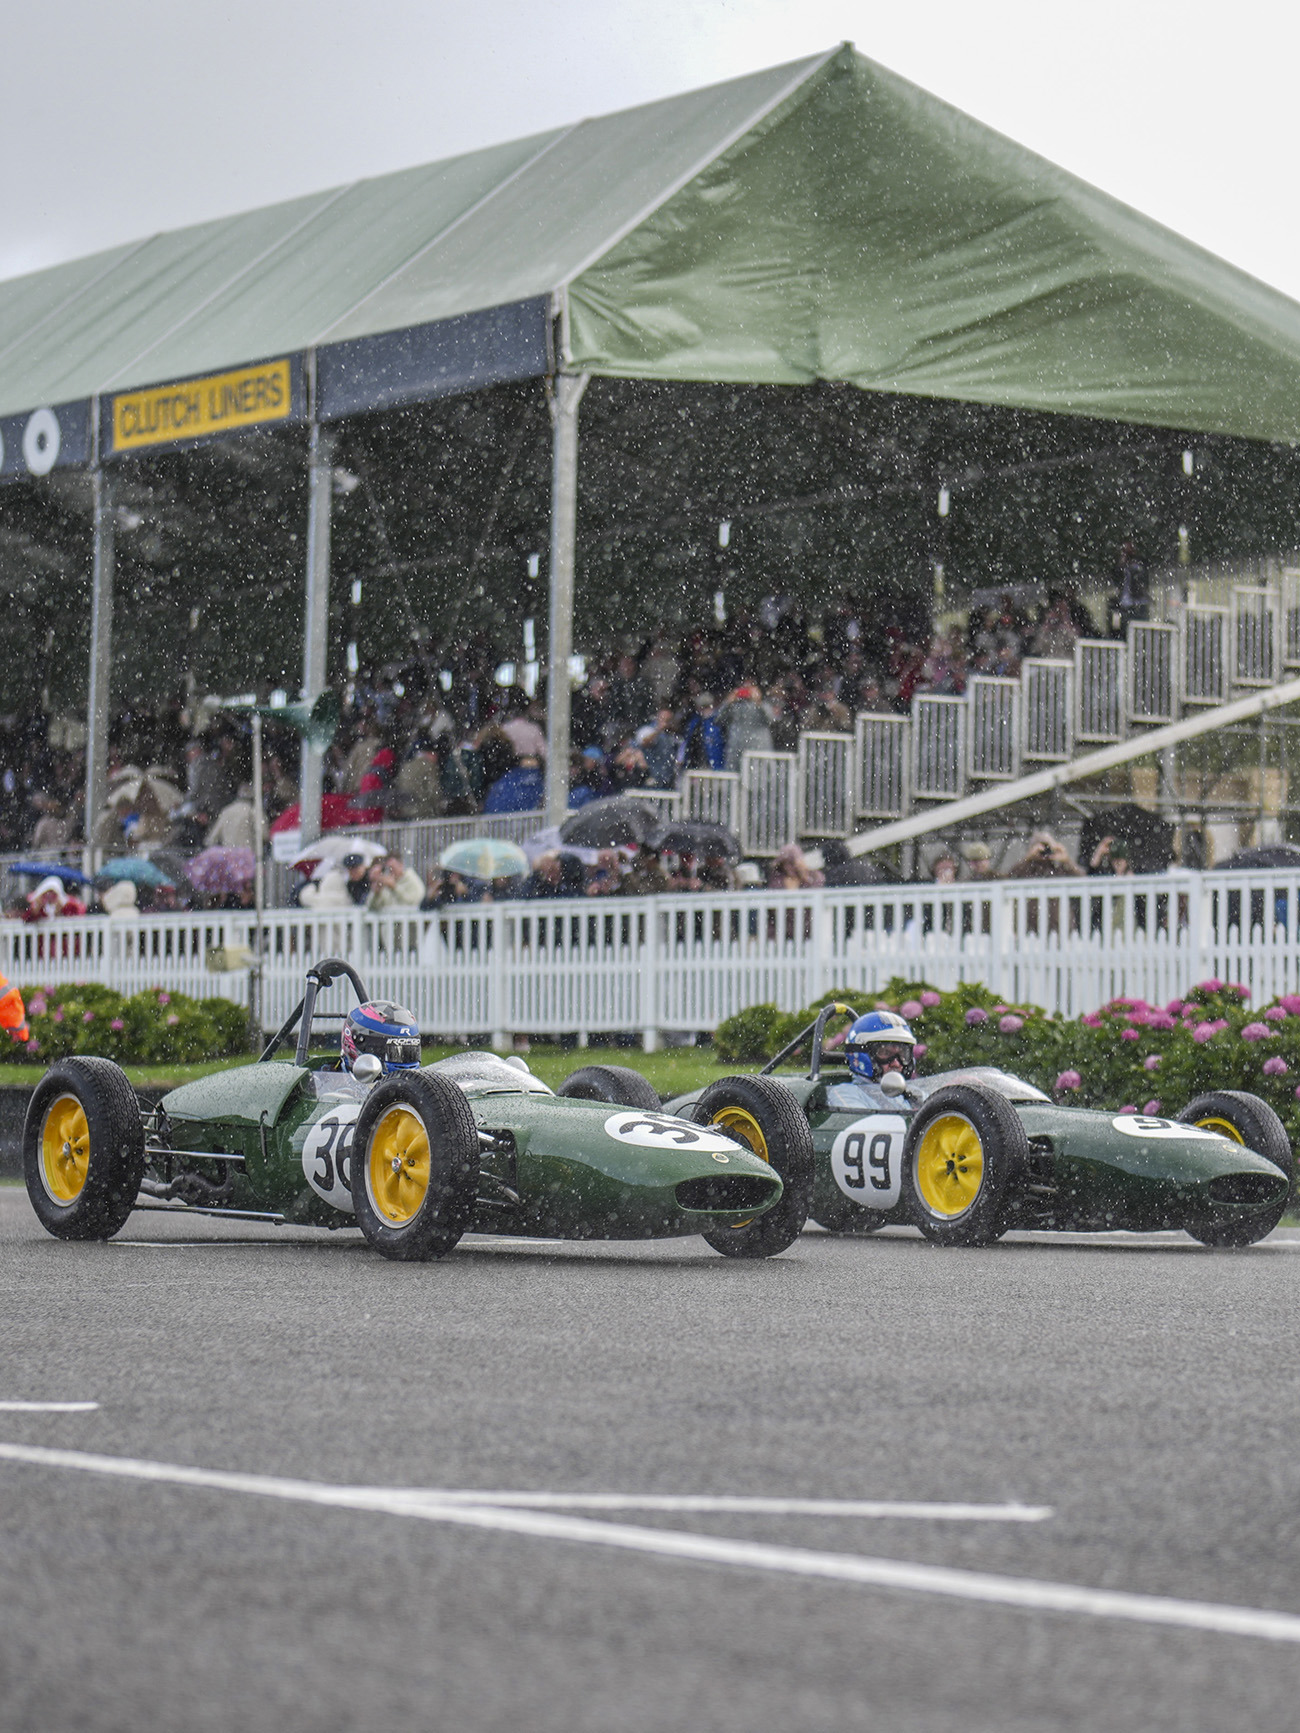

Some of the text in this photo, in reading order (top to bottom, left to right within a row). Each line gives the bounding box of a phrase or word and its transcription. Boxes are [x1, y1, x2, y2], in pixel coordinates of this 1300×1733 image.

[119, 371, 284, 438] CLUTCH LINERS
[843, 1132, 892, 1190] 99
